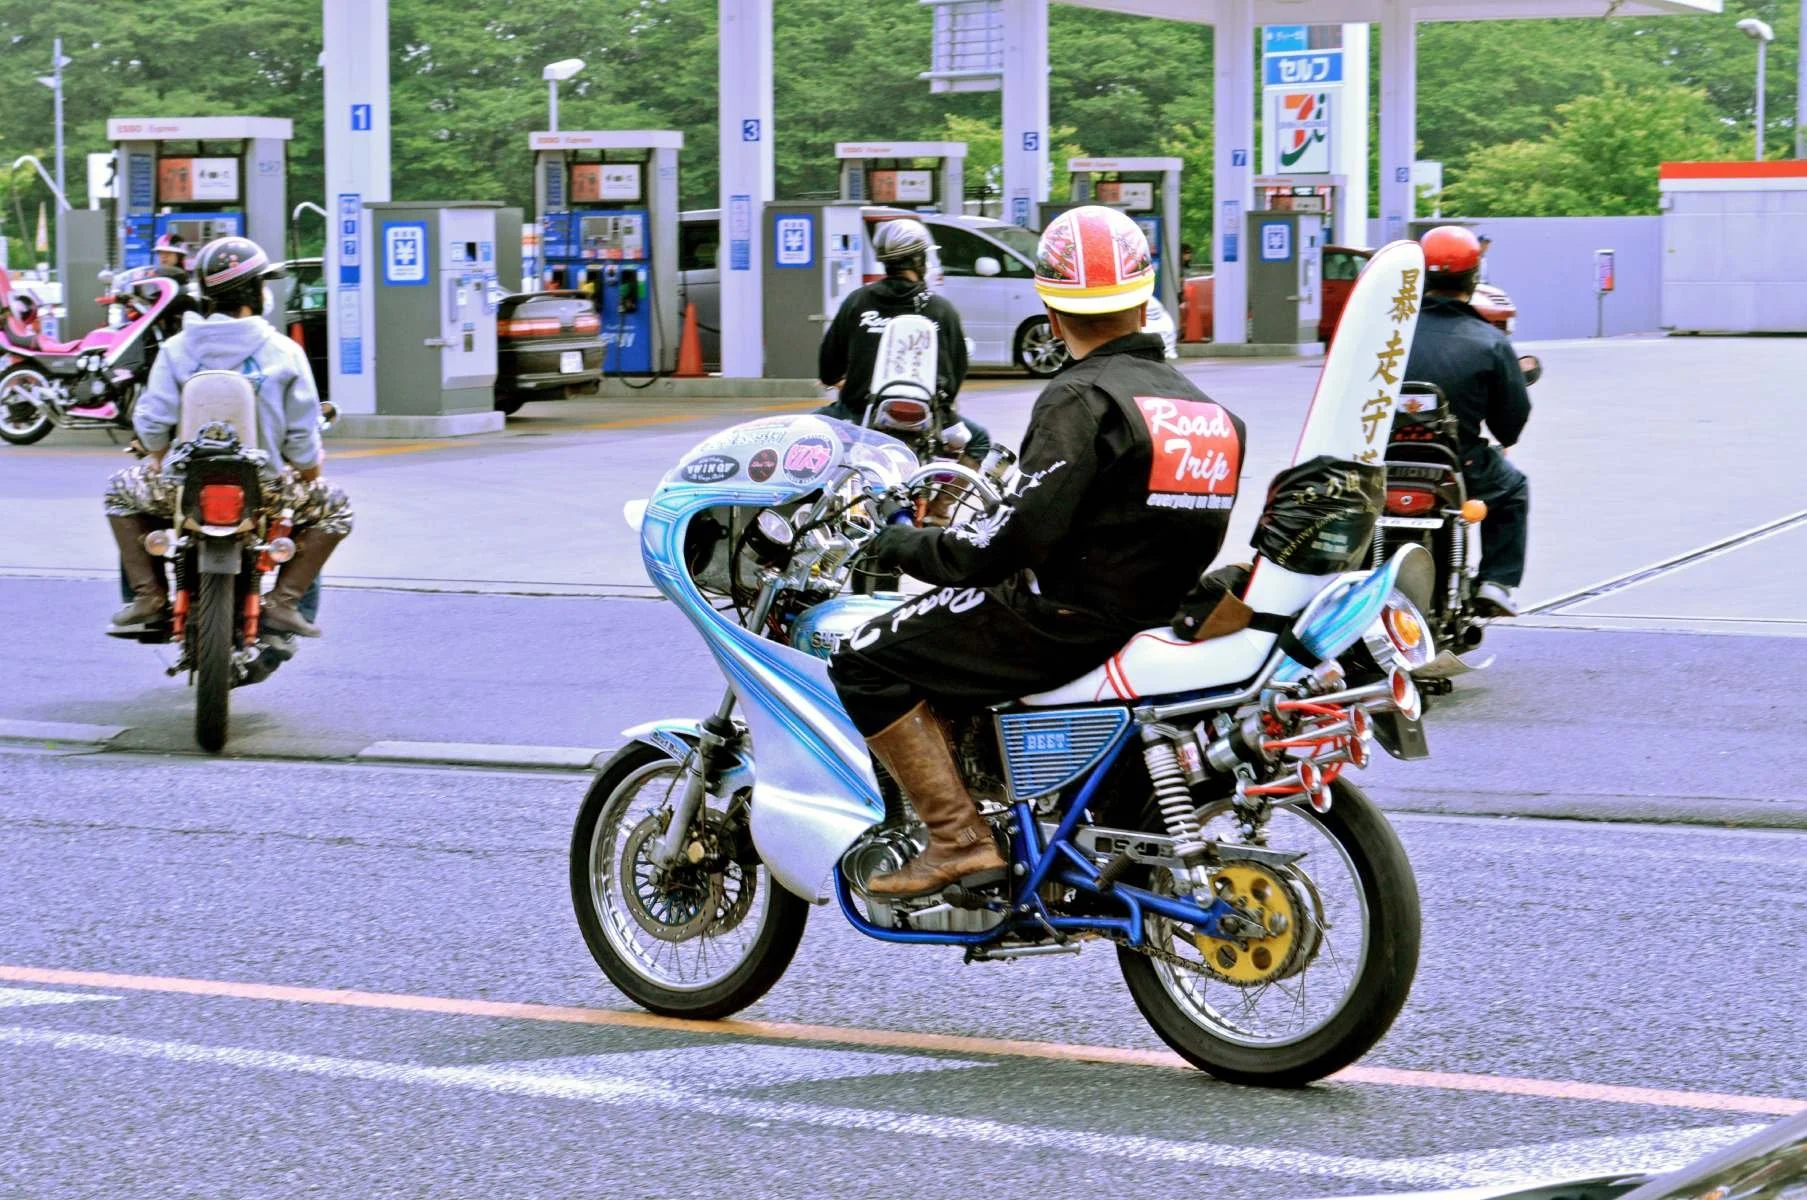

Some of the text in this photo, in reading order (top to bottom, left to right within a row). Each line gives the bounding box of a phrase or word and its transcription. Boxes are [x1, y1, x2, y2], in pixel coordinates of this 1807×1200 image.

[1279, 57, 1330, 82] セルフ
[354, 106, 367, 129] 1
[743, 120, 758, 140] 3
[1024, 132, 1038, 151] 5
[1233, 150, 1246, 166] 7
[1144, 400, 1231, 438] Road
[1164, 439, 1231, 491] Trip
[1026, 733, 1066, 749] BEET
